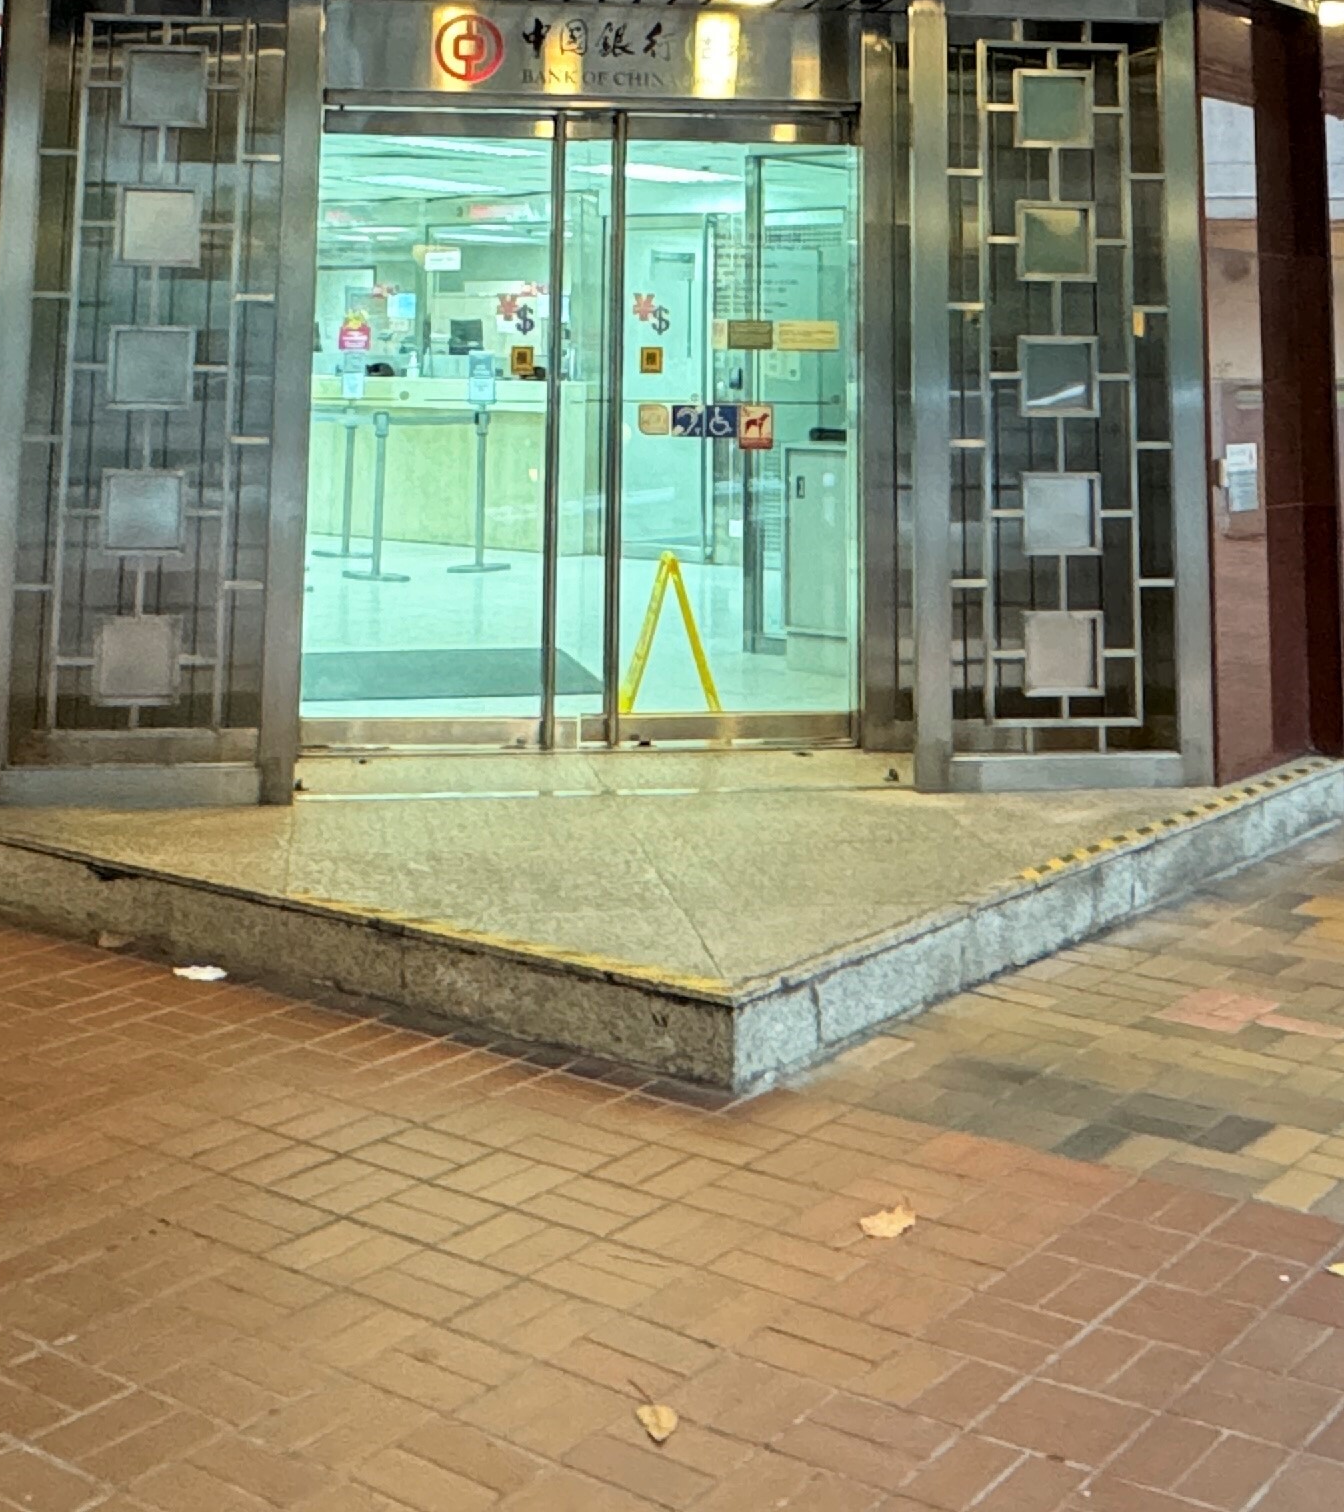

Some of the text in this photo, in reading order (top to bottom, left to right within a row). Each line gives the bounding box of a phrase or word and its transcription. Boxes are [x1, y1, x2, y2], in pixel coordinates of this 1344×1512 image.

[521, 69, 577, 85] BANK
[583, 70, 606, 86] OF
[612, 71, 679, 88] CHINA
